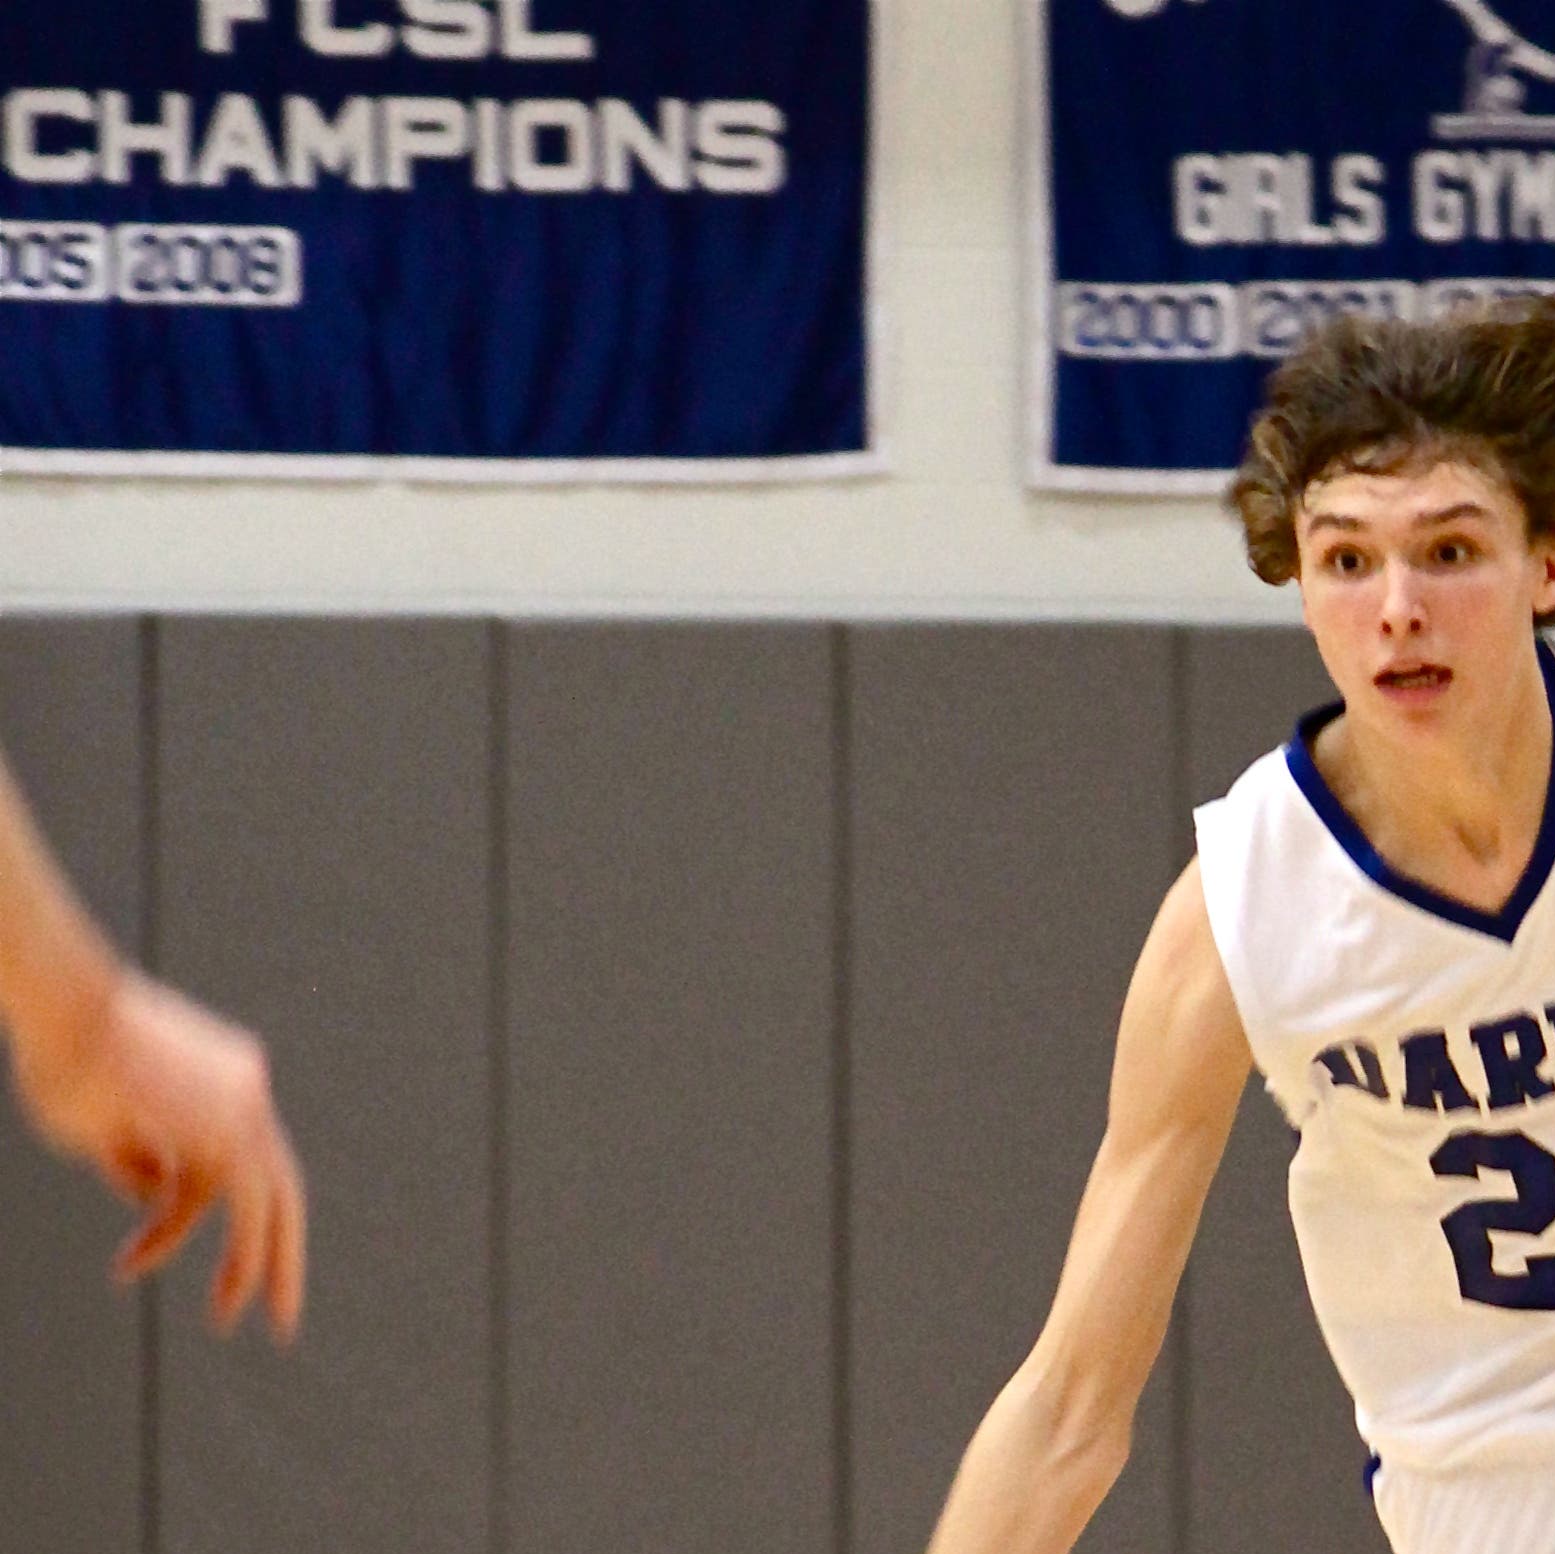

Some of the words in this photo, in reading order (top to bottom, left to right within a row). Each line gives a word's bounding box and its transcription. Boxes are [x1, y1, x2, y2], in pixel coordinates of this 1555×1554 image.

[199, 0, 597, 62] FCSL
[2, 86, 788, 193] CHAMPIONS
[1173, 150, 1387, 246] GIRLS
[132, 233, 281, 296] 2008
[1074, 290, 1219, 348] 2000
